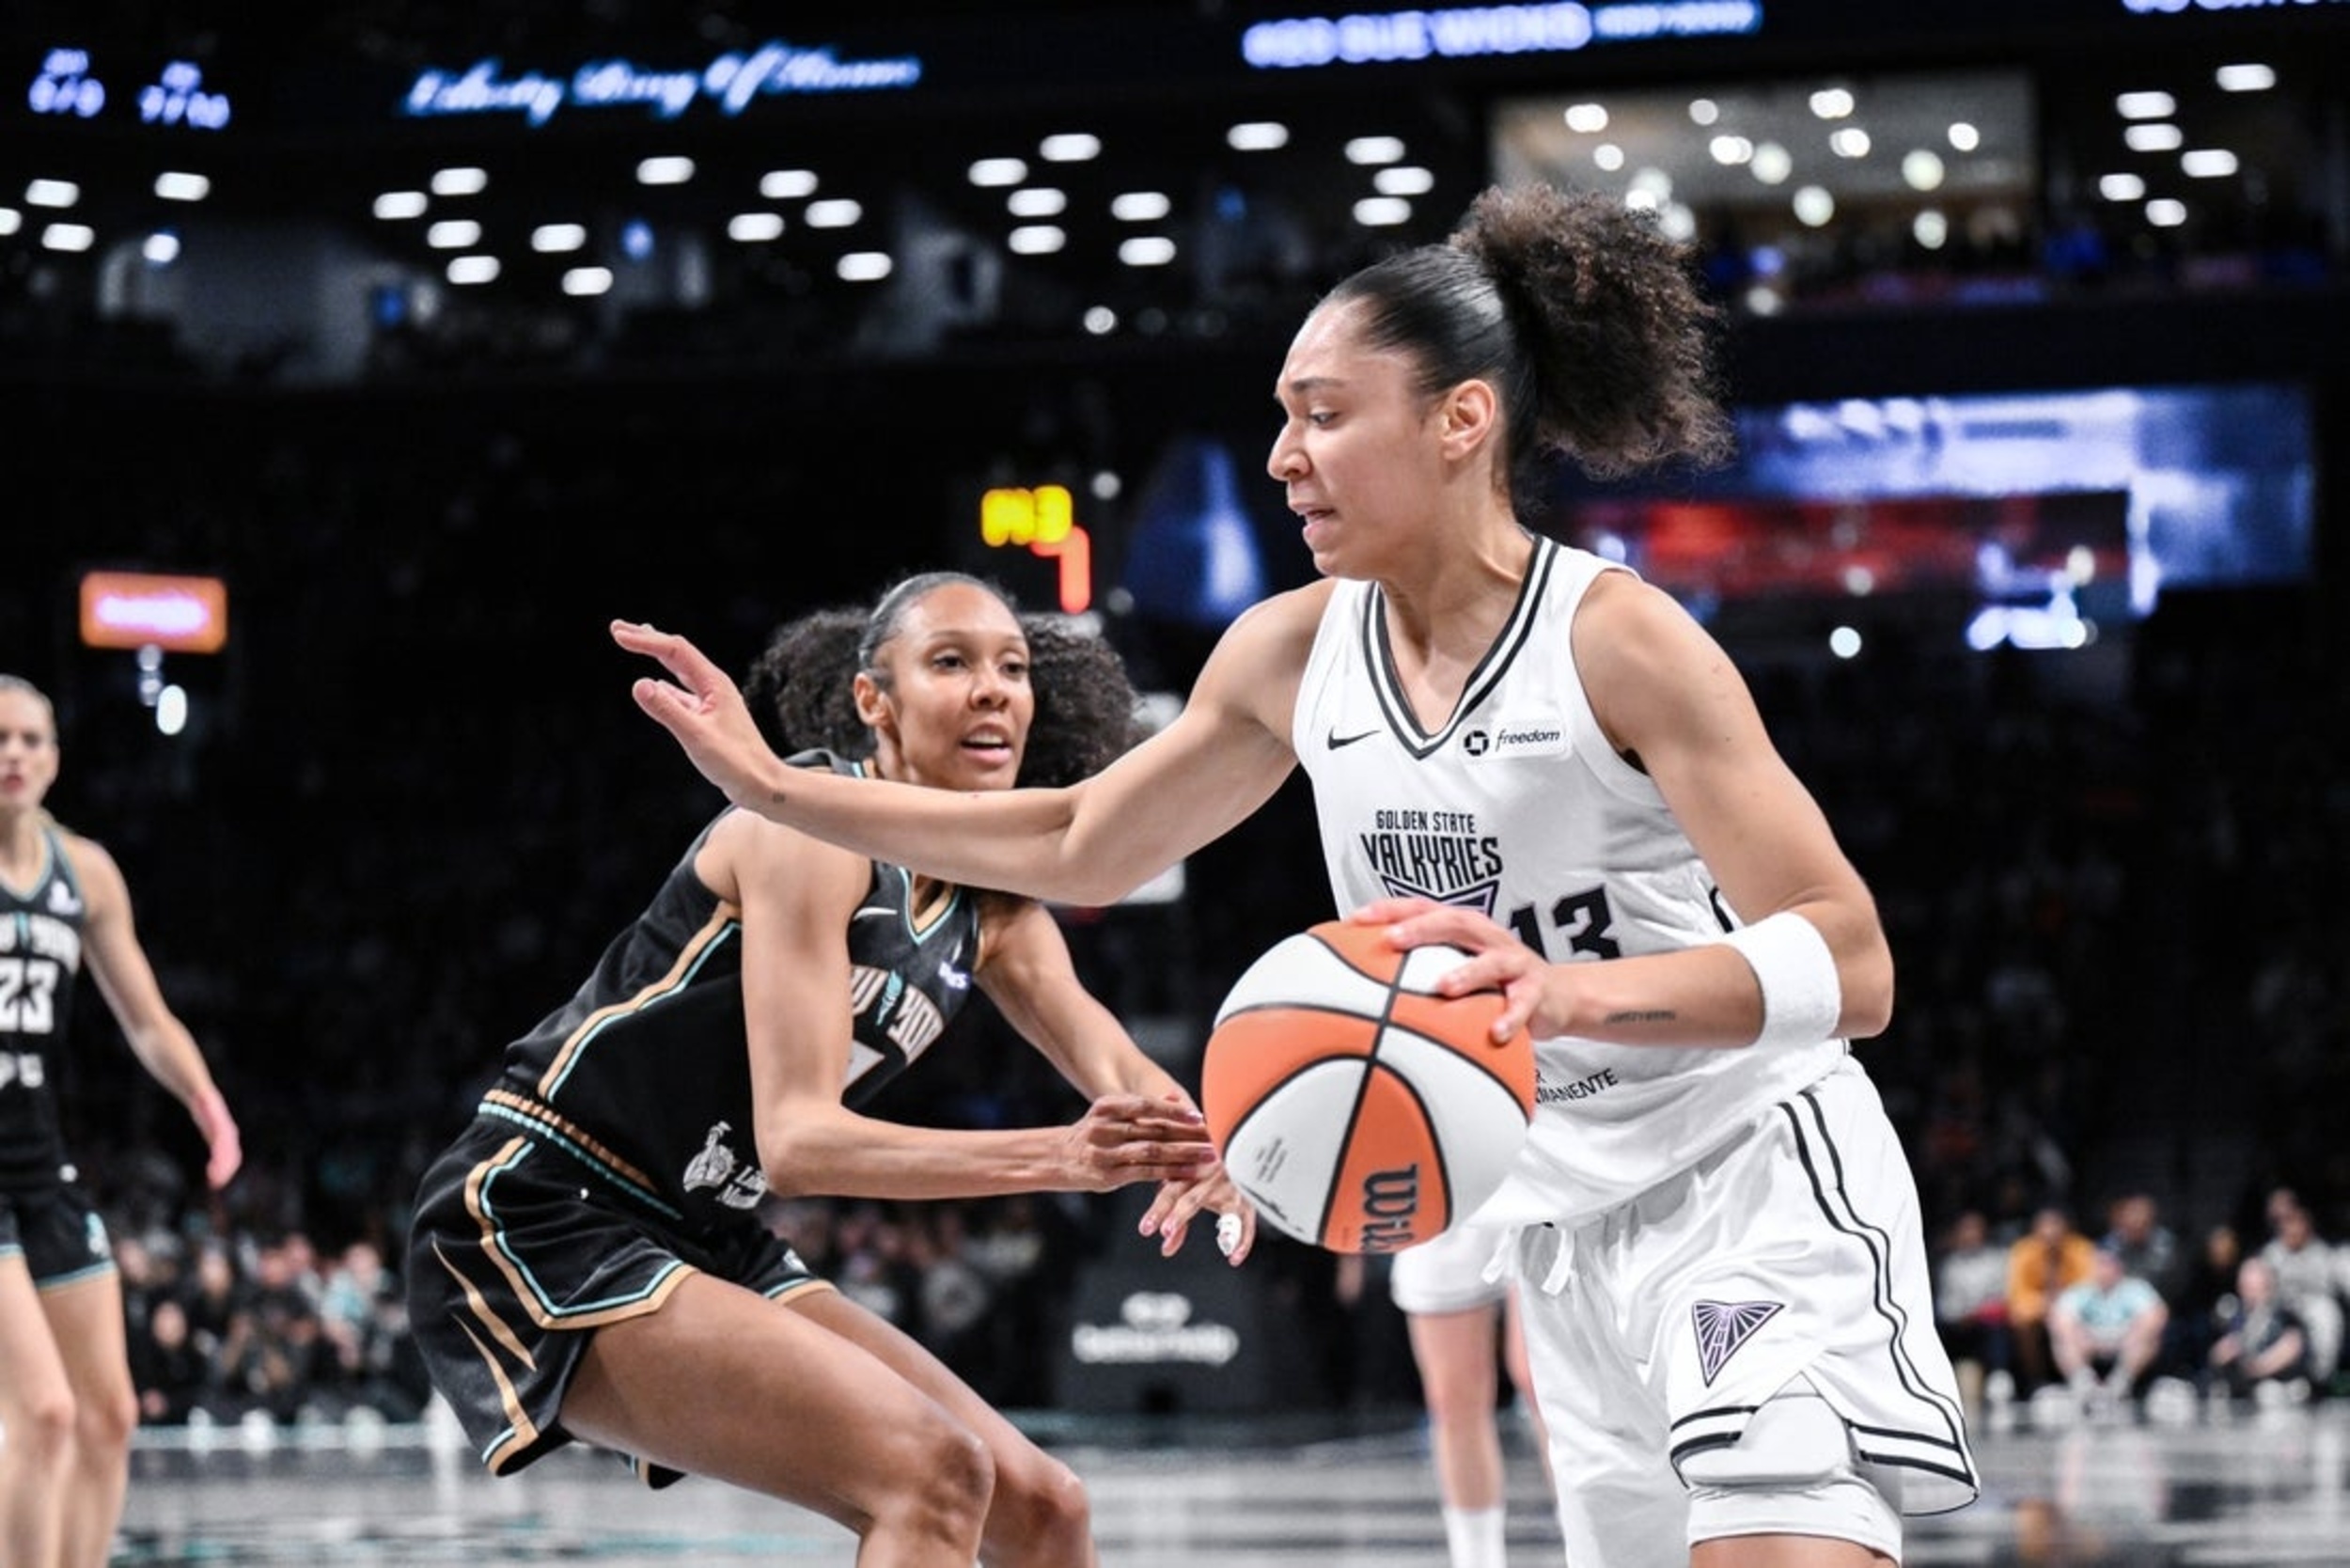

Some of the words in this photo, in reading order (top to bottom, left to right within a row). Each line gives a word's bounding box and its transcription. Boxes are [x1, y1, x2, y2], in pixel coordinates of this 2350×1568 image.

[1495, 728, 1560, 752] freedom
[1376, 809, 1428, 831] GOLDEN
[1434, 810, 1477, 834] STATE
[1360, 833, 1504, 894] VALKYRIES
[1507, 882, 1623, 964] 13
